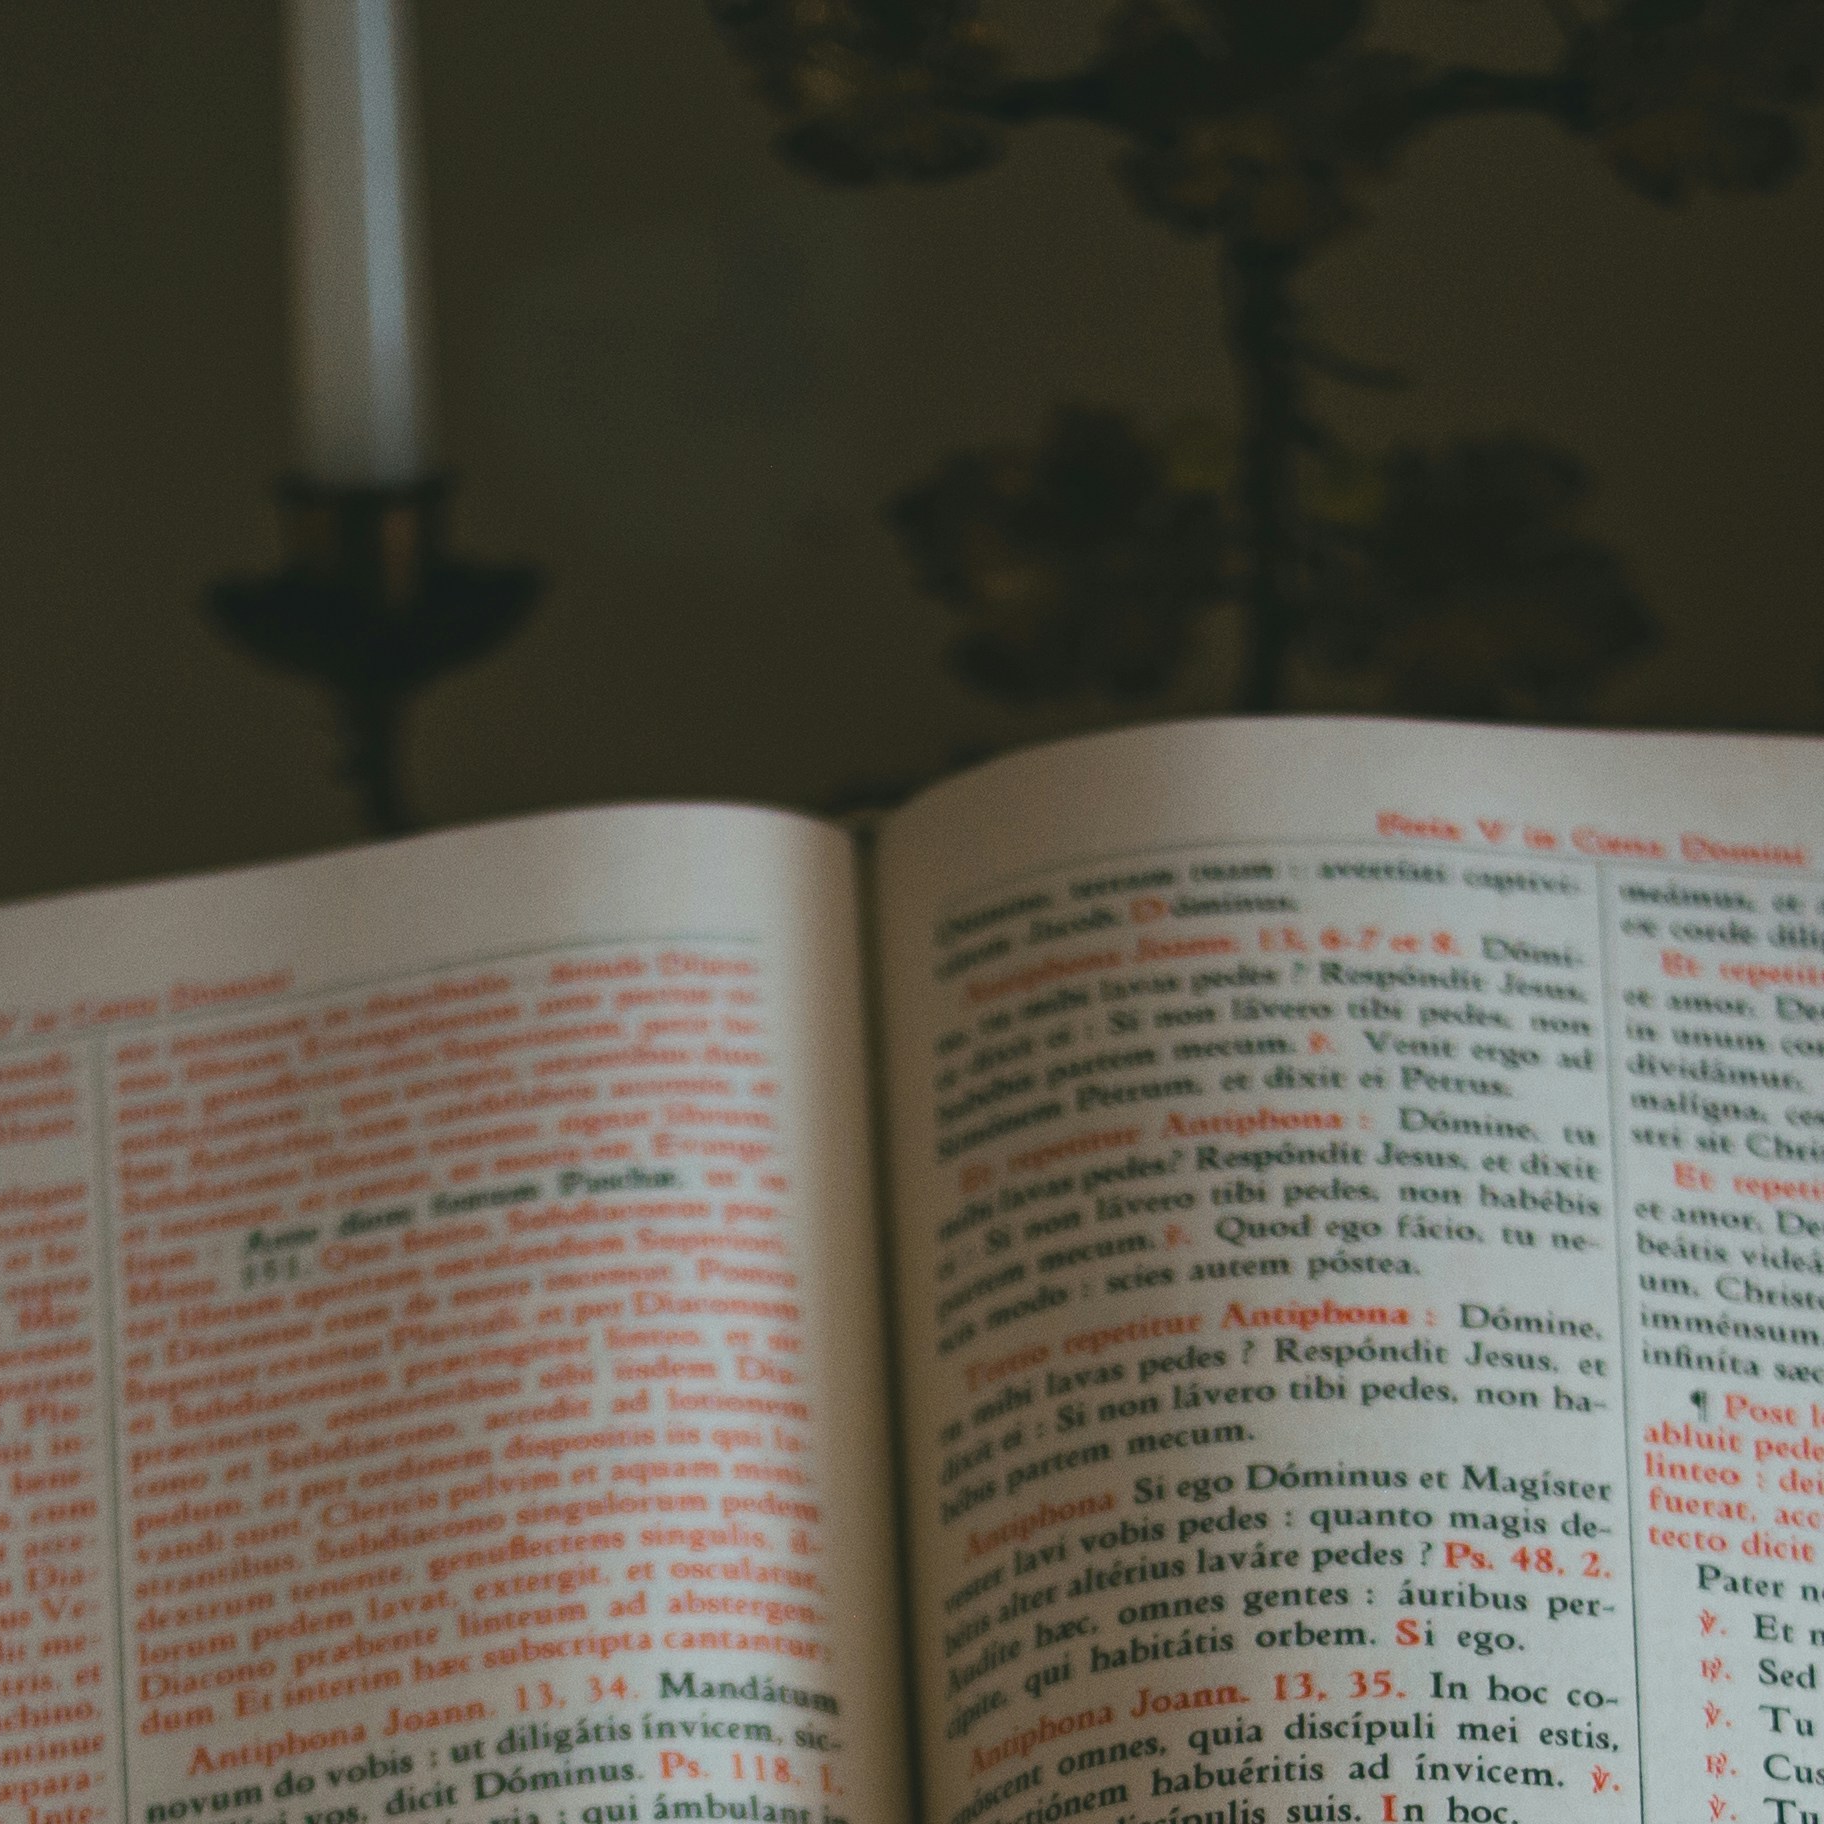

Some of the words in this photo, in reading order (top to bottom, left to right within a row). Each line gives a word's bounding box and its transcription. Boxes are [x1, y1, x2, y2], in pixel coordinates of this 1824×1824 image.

[1133, 1475, 1168, 1505] Si
[1175, 1474, 1237, 1504] ego
[1246, 1461, 1409, 1492] Dóminus
[1419, 1470, 1448, 1490] et
[1463, 1464, 1611, 1502] Magíster
[1697, 1563, 1785, 1599] Pater
[1754, 1613, 1794, 1643] Et
[1129, 1684, 1251, 1720] Joann.
[1274, 1671, 1328, 1702] 13,
[1350, 1669, 1406, 1699] 35.
[1431, 1670, 1469, 1701] In
[1488, 1674, 1548, 1705] hoc
[1566, 1688, 1618, 1709] co-
